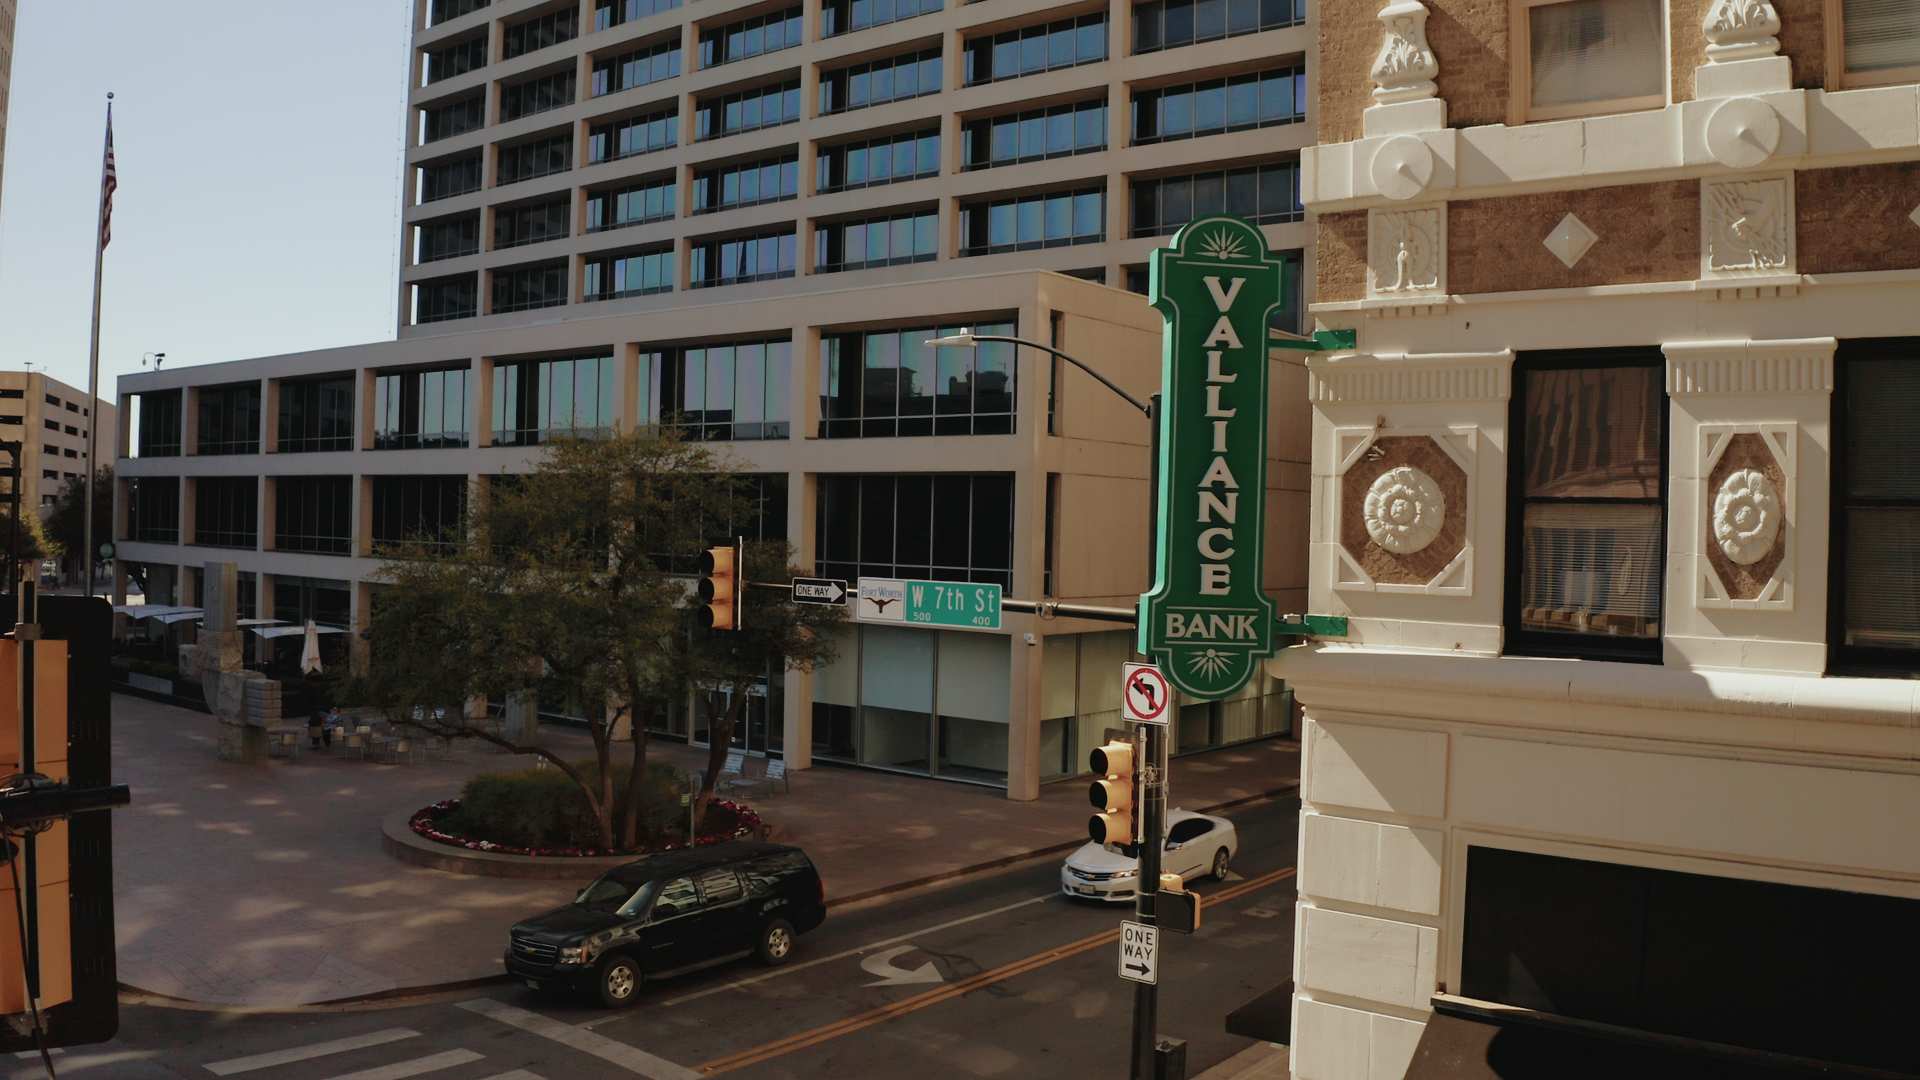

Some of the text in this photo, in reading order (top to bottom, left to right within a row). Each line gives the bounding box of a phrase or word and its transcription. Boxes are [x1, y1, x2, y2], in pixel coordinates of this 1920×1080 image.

[1197, 276, 1246, 595] VALLIANCE
[797, 585, 830, 597] ONE WAY
[861, 586, 903, 599] FORT WORTH
[912, 585, 995, 613] W 7th St
[913, 611, 991, 626] 500 400
[1165, 613, 1258, 639] BANK
[1125, 928, 1153, 946] ONE
[1124, 943, 1153, 961] WAY
